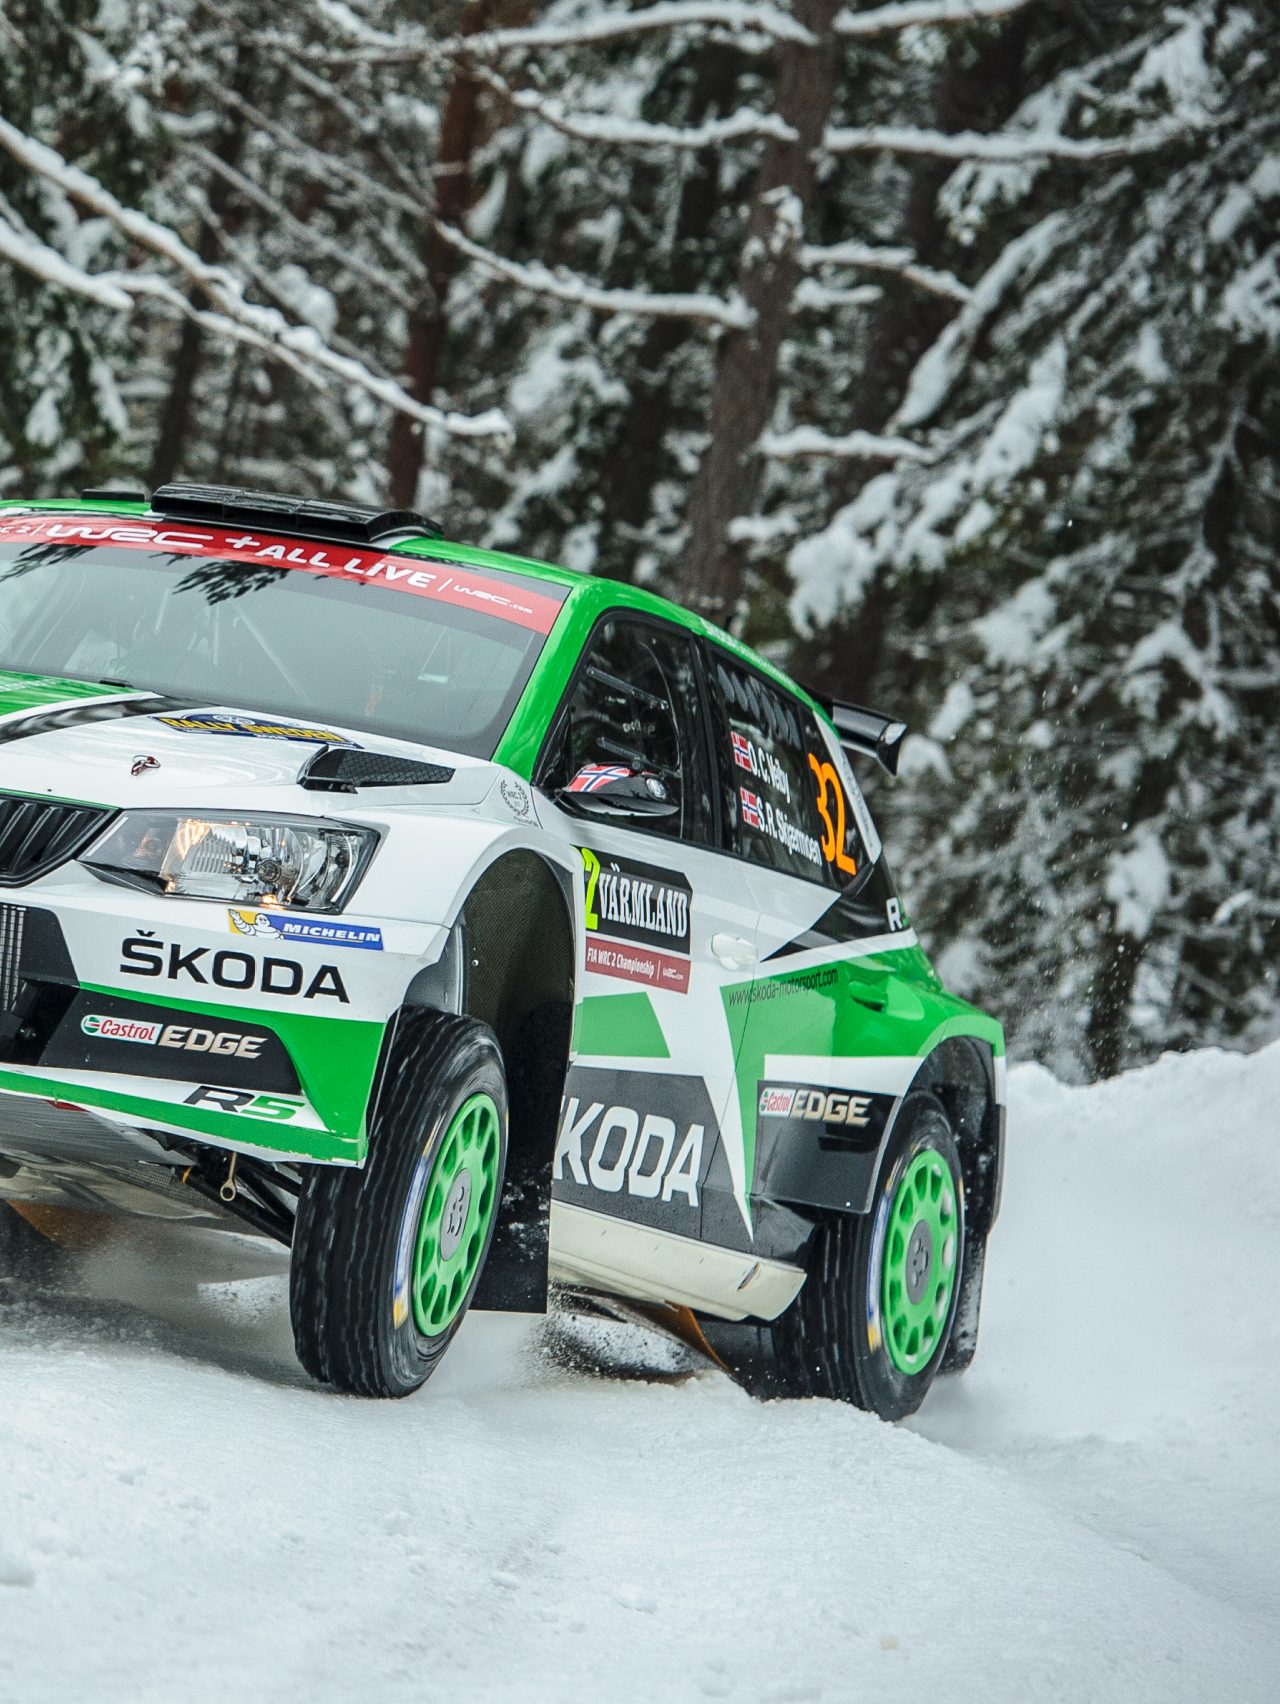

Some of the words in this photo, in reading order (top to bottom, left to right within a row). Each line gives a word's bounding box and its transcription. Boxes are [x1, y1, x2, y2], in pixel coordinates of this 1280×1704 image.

[18, 525, 31, 534] 2
[46, 524, 214, 549] WRC
[343, 557, 437, 589] LIVE
[158, 716, 239, 731] RALLY
[240, 723, 346, 742] SWEDEN
[807, 752, 857, 876] 32
[598, 862, 688, 938] VÄRMLAND
[282, 922, 382, 943] MICHELIN
[119, 929, 351, 1004] ŠKODA
[586, 947, 598, 963] FIA
[598, 949, 612, 967] WRC
[611, 951, 617, 968] 2
[616, 953, 655, 979] Championship
[728, 967, 840, 1008] www.skoda-motorsport.com
[100, 1019, 157, 1041] Castrol
[158, 1024, 269, 1059] EDGE
[183, 1085, 307, 1120] R5
[766, 1091, 793, 1113] Castrol
[789, 1088, 874, 1128] EDGE
[552, 1094, 705, 1208] KODA
